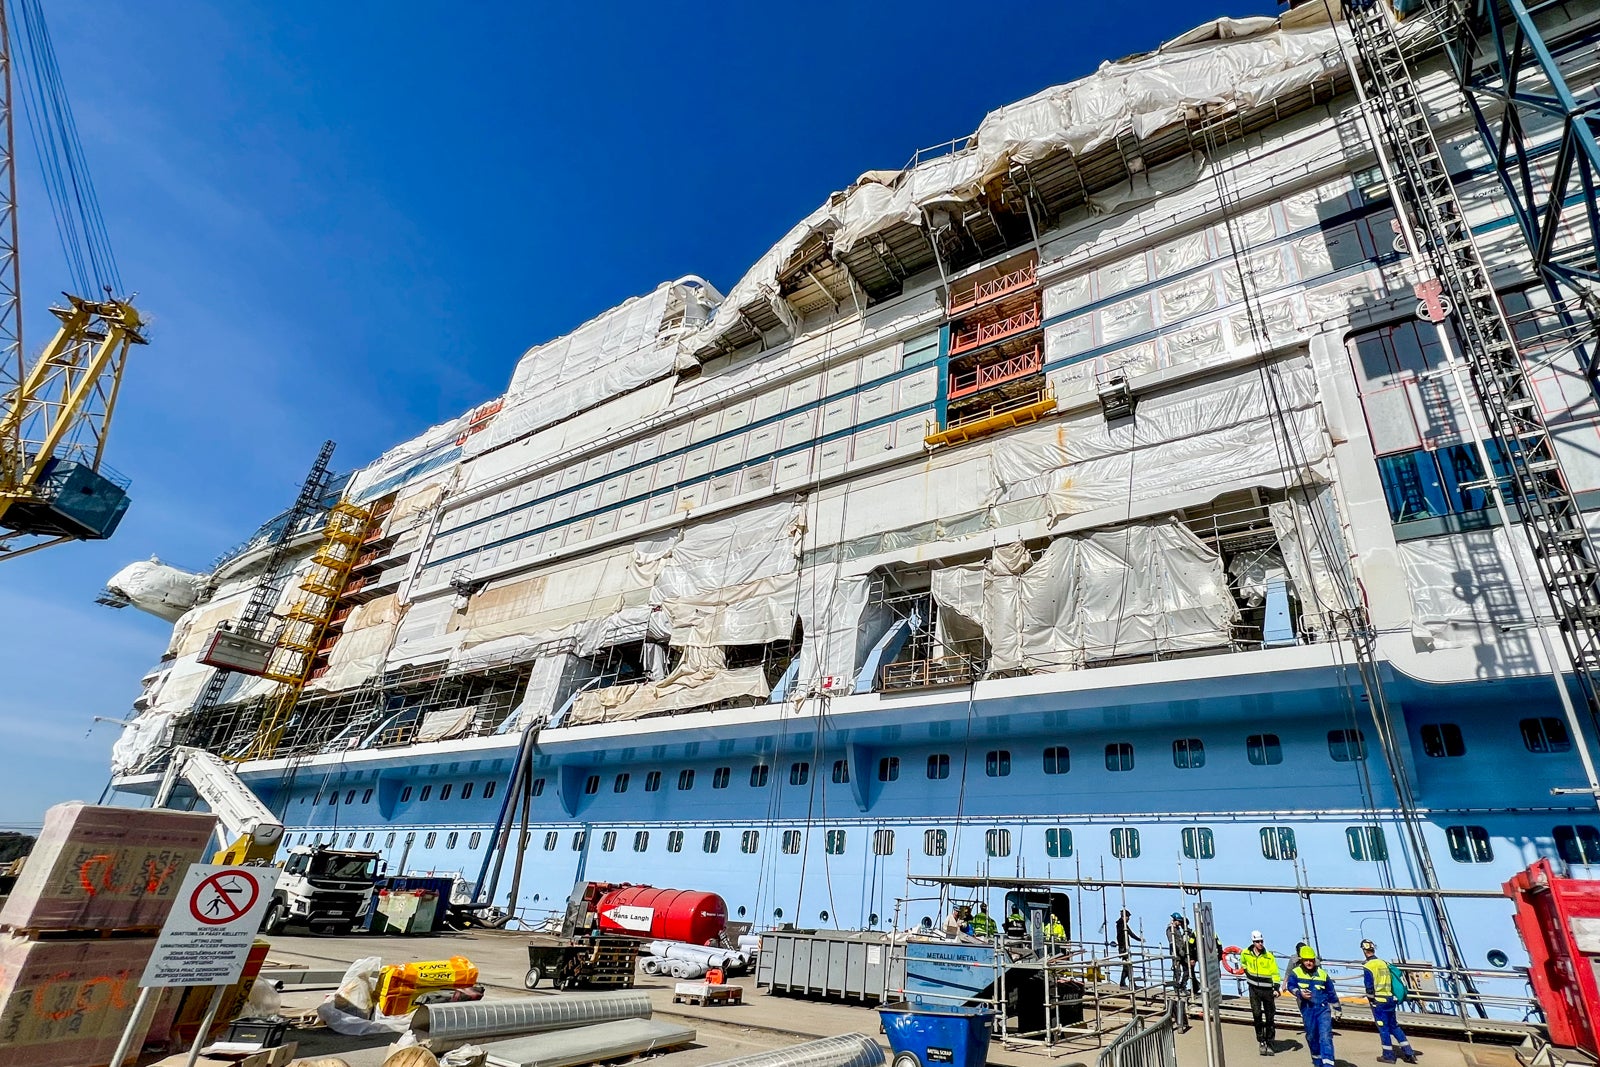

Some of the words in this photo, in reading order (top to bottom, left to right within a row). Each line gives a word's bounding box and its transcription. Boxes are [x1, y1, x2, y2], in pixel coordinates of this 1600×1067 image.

[835, 677, 841, 685] 2
[630, 913, 650, 922] Langh
[957, 954, 978, 962] METAL
